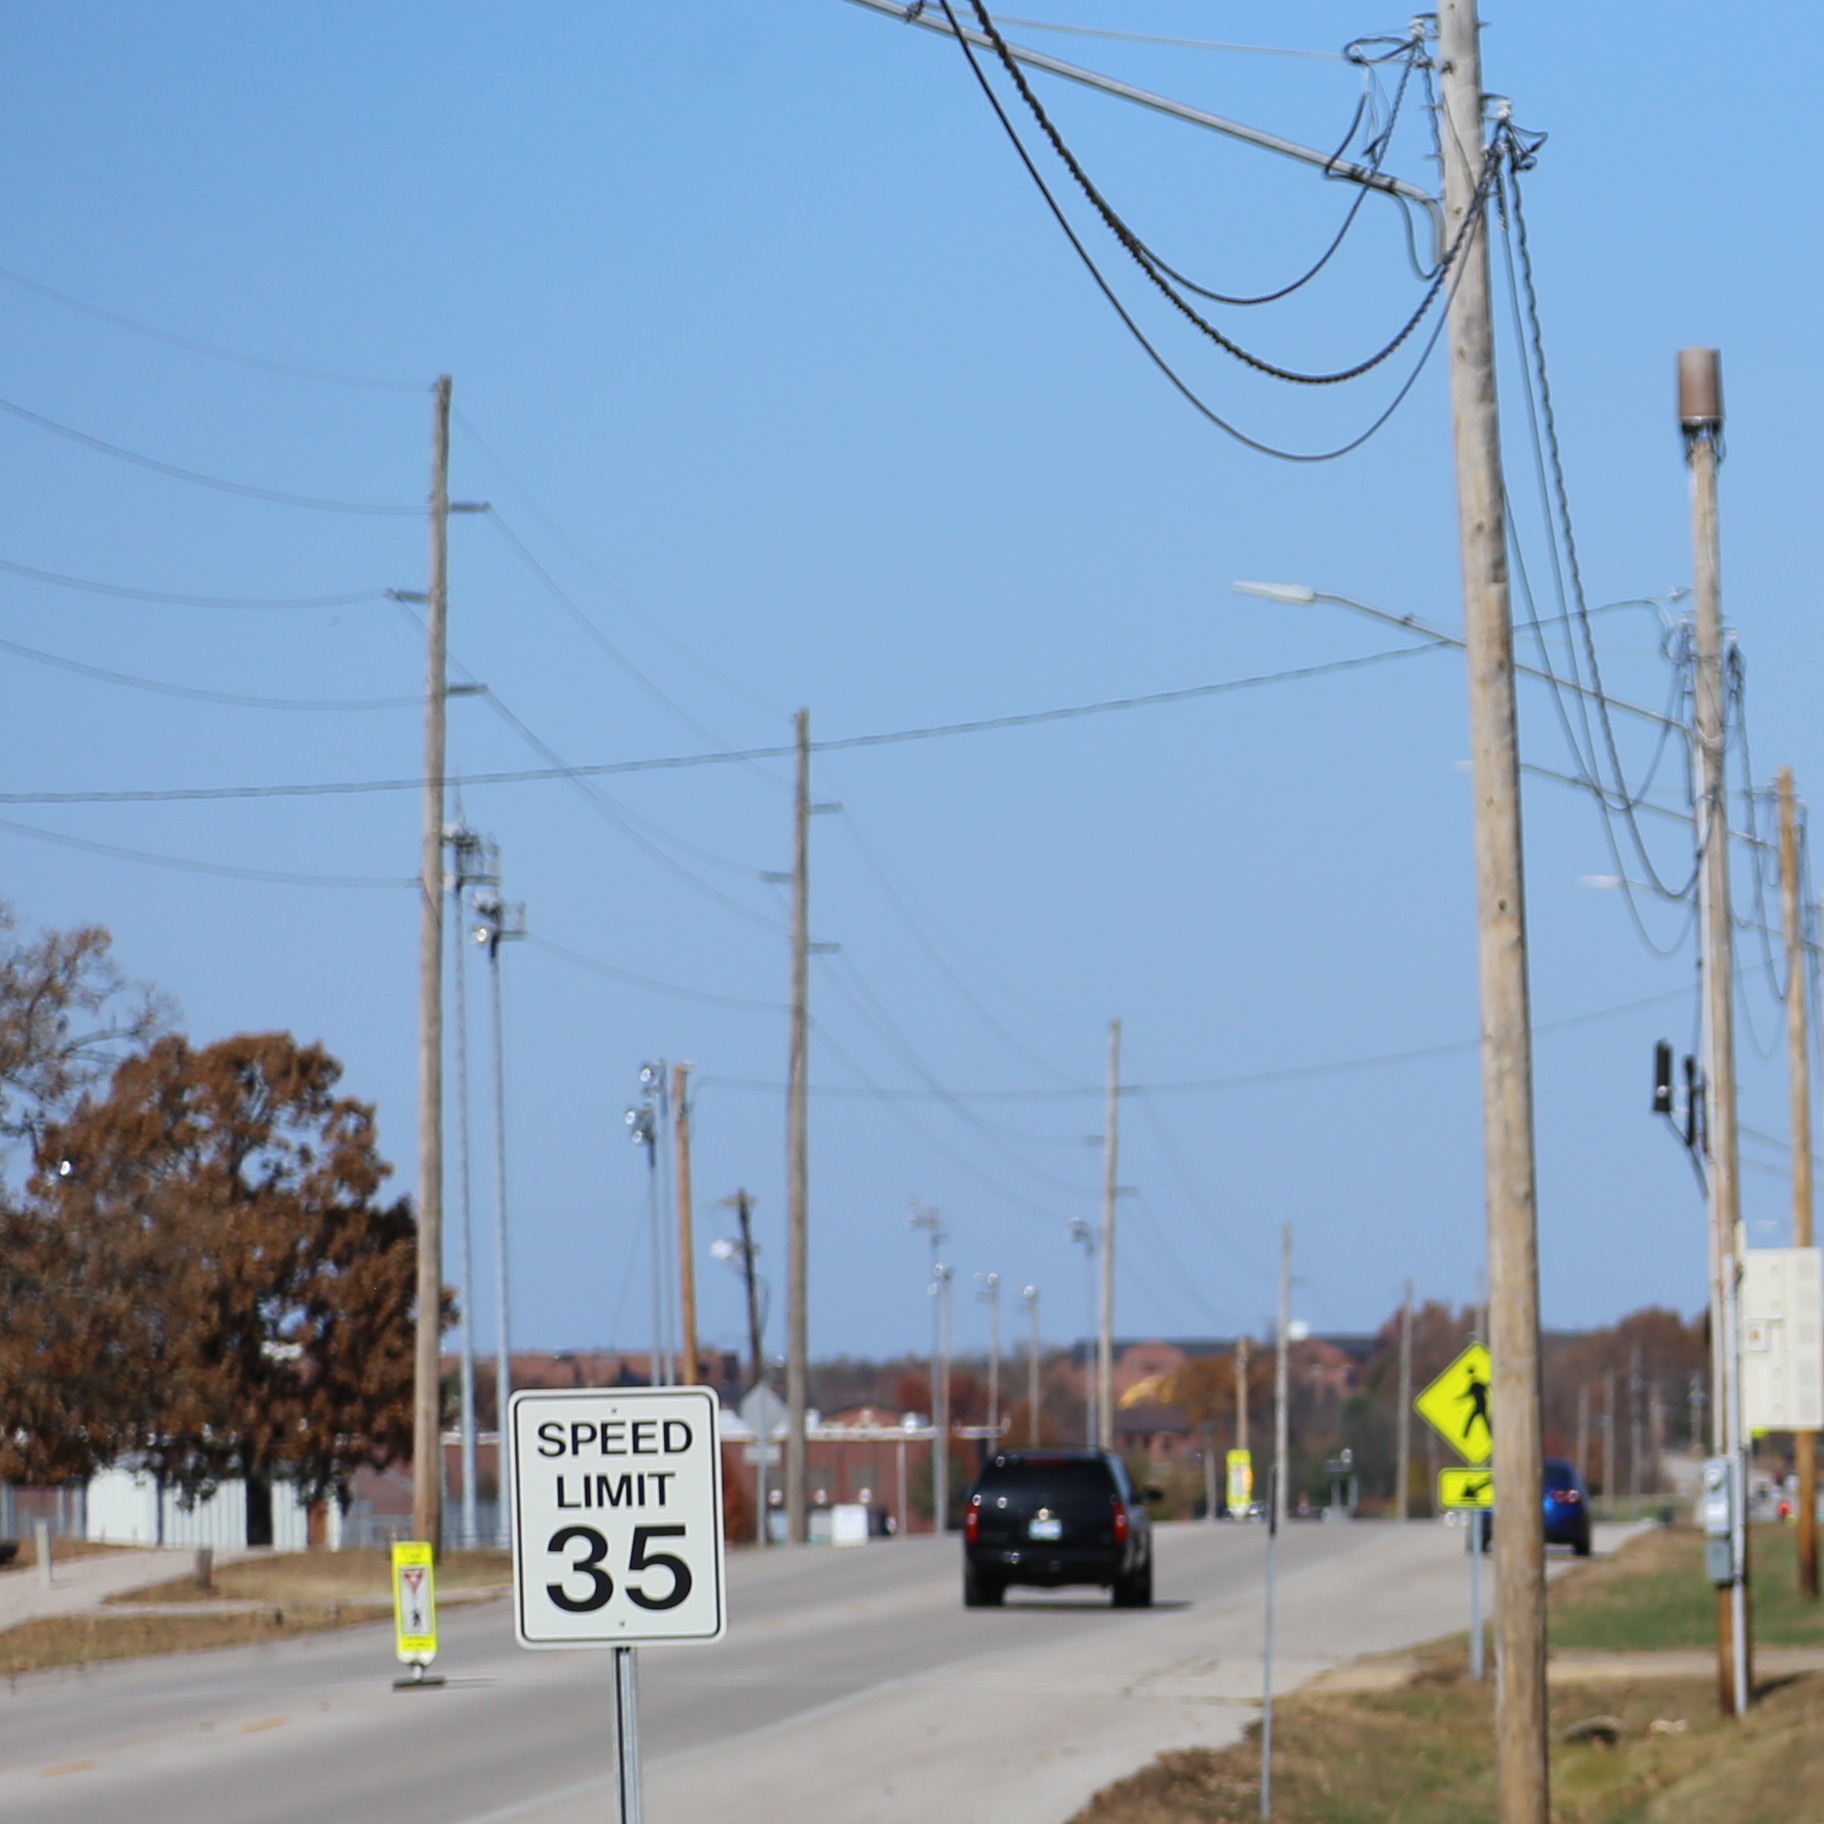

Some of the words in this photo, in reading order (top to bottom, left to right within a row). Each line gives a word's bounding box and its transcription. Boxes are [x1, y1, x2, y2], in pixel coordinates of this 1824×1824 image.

[537, 1419, 693, 1457] SPEED
[556, 1471, 676, 1509] LIMIT
[546, 1522, 693, 1613] 35
